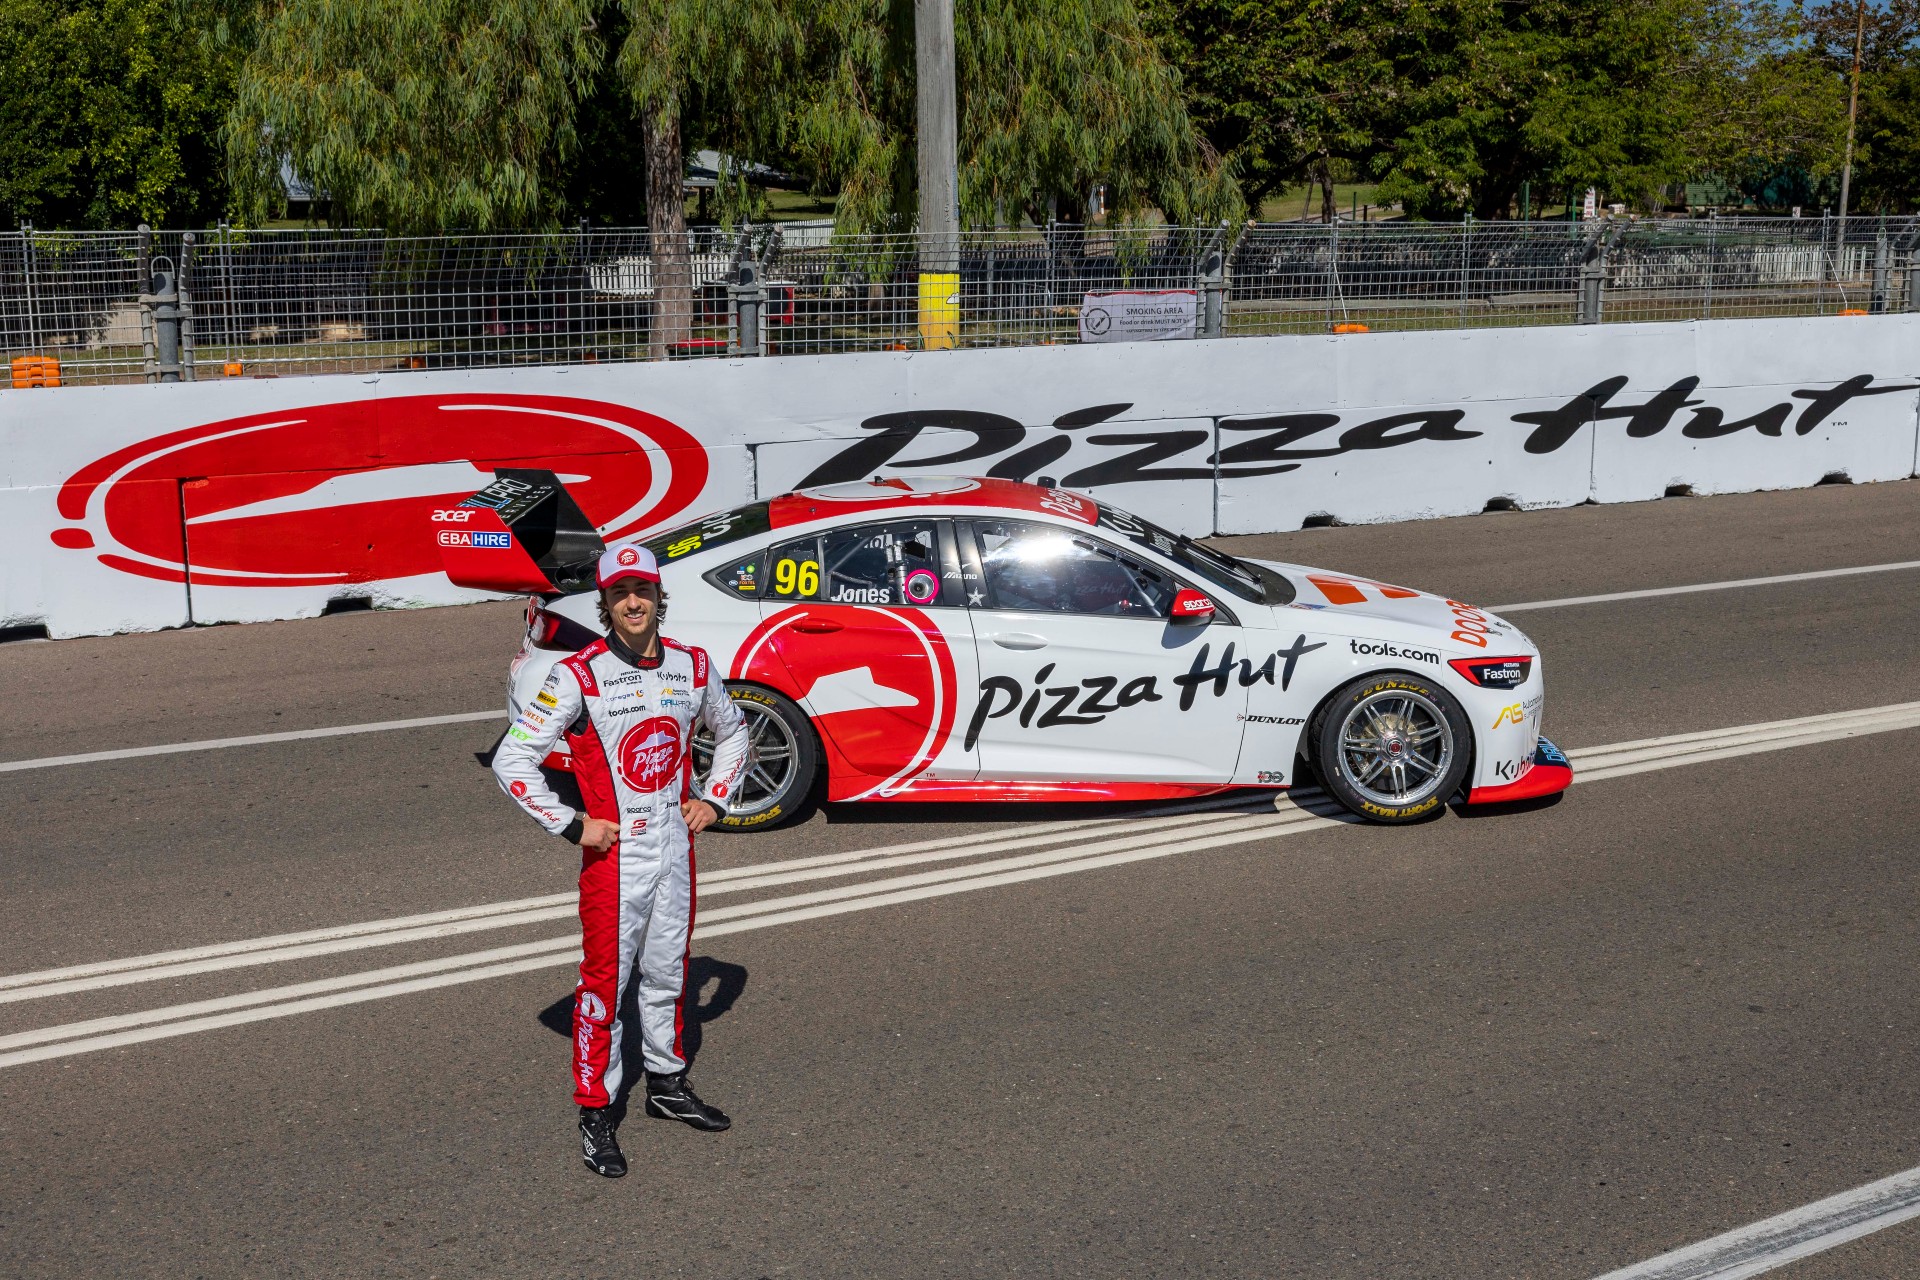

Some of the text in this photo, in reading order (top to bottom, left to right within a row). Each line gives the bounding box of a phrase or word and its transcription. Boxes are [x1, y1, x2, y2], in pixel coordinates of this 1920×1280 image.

[1126, 307, 1162, 315] SMOKING
[790, 374, 1920, 488] Pizza Hut
[431, 509, 476, 522] acer
[440, 533, 508, 546] EBA HIRE
[775, 558, 820, 596] 96
[831, 584, 890, 603] Jones
[1350, 639, 1440, 664] tools.com
[1484, 668, 1521, 679] Fastron
[603, 674, 642, 688] Fastron
[730, 689, 777, 705] NLOP
[964, 634, 1327, 752] Pizza Hut
[608, 704, 646, 717] tools.com
[1246, 714, 1306, 726] DUNLOP
[632, 745, 674, 773] Pizza
[626, 806, 652, 814] sparco
